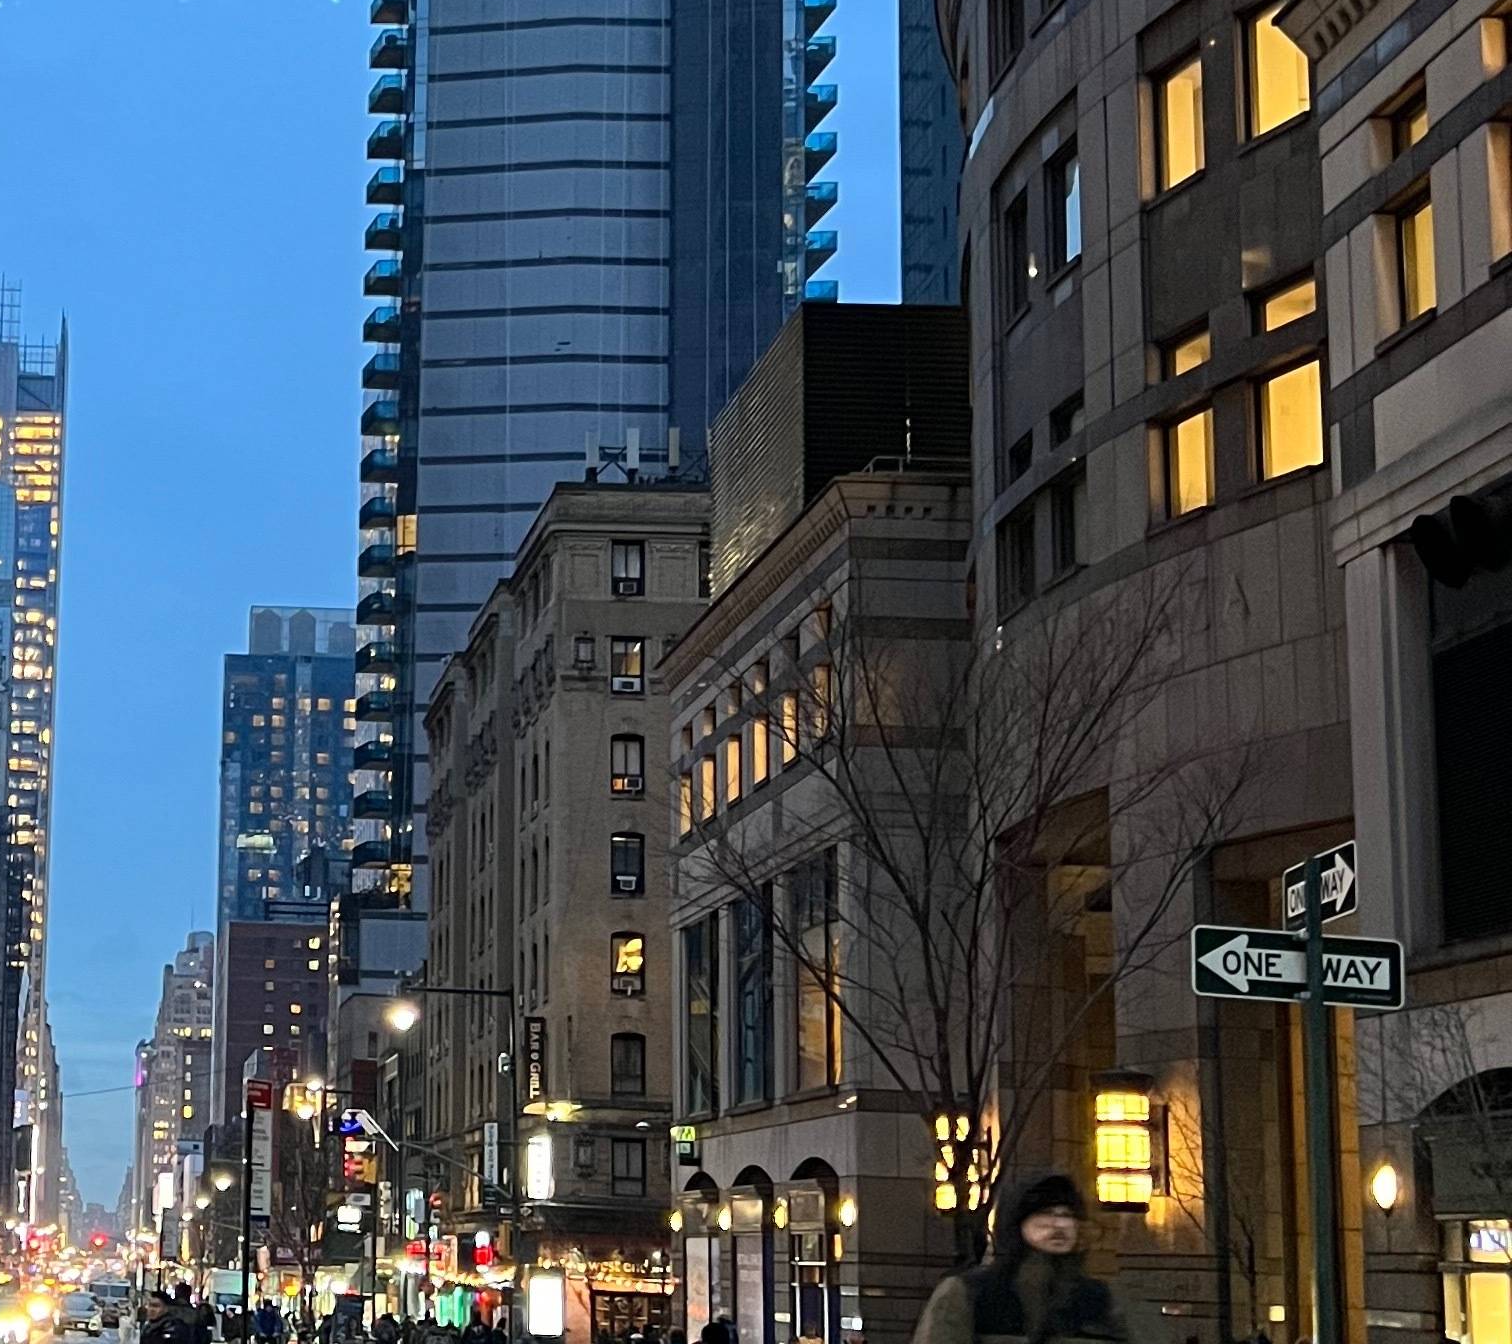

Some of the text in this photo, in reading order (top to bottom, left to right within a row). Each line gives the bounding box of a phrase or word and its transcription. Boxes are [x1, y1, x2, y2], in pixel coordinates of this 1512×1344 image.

[1290, 867, 1346, 913] ON WAY
[1222, 950, 1382, 985] ONE WAY
[529, 1022, 542, 1050] BAR
[529, 1062, 542, 1099] GRILL
